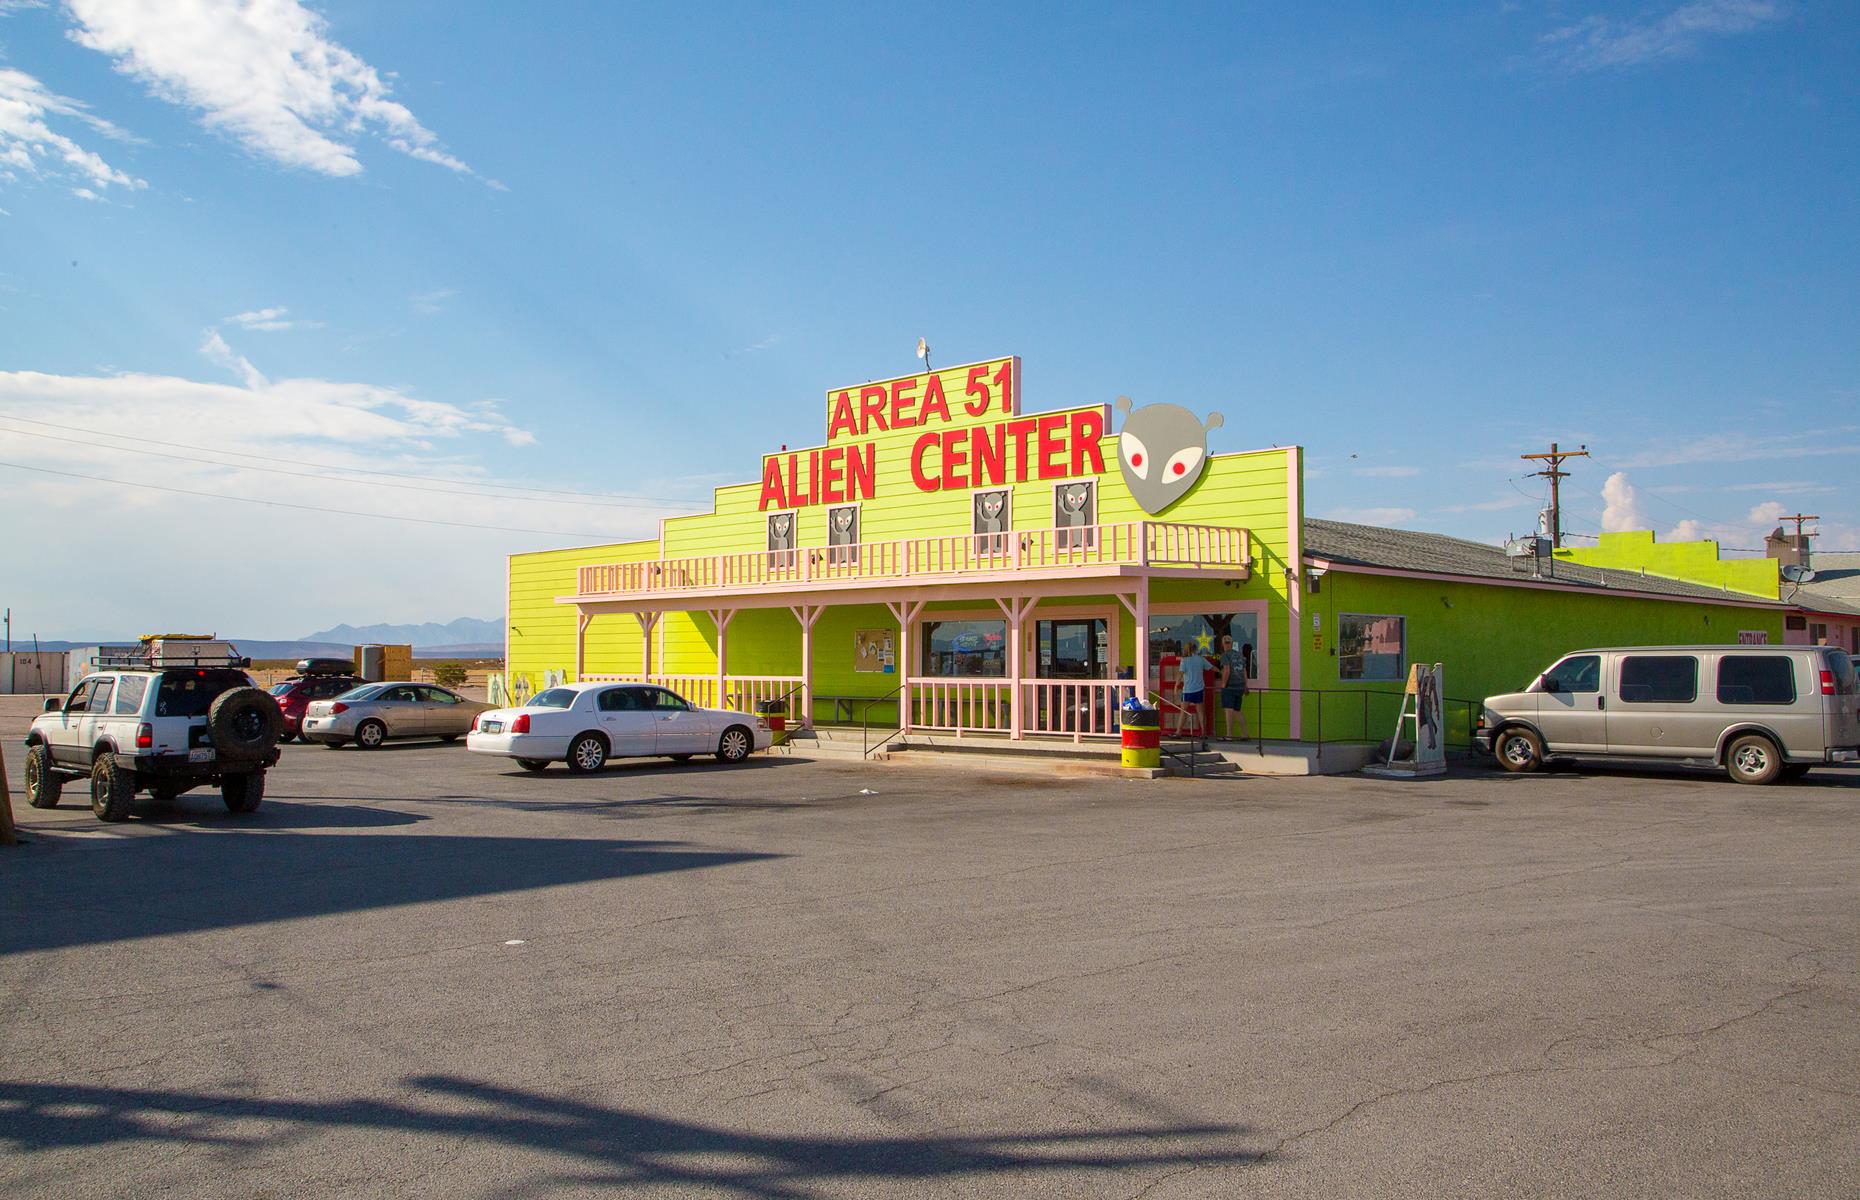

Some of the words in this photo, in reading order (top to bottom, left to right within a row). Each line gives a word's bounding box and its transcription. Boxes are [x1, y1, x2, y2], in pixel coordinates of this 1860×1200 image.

[829, 375, 951, 440] AREA
[964, 362, 1011, 417] 51
[759, 442, 876, 511] ALIEN
[911, 410, 1106, 492] CENTER
[1739, 632, 1767, 645] ENTRANCE
